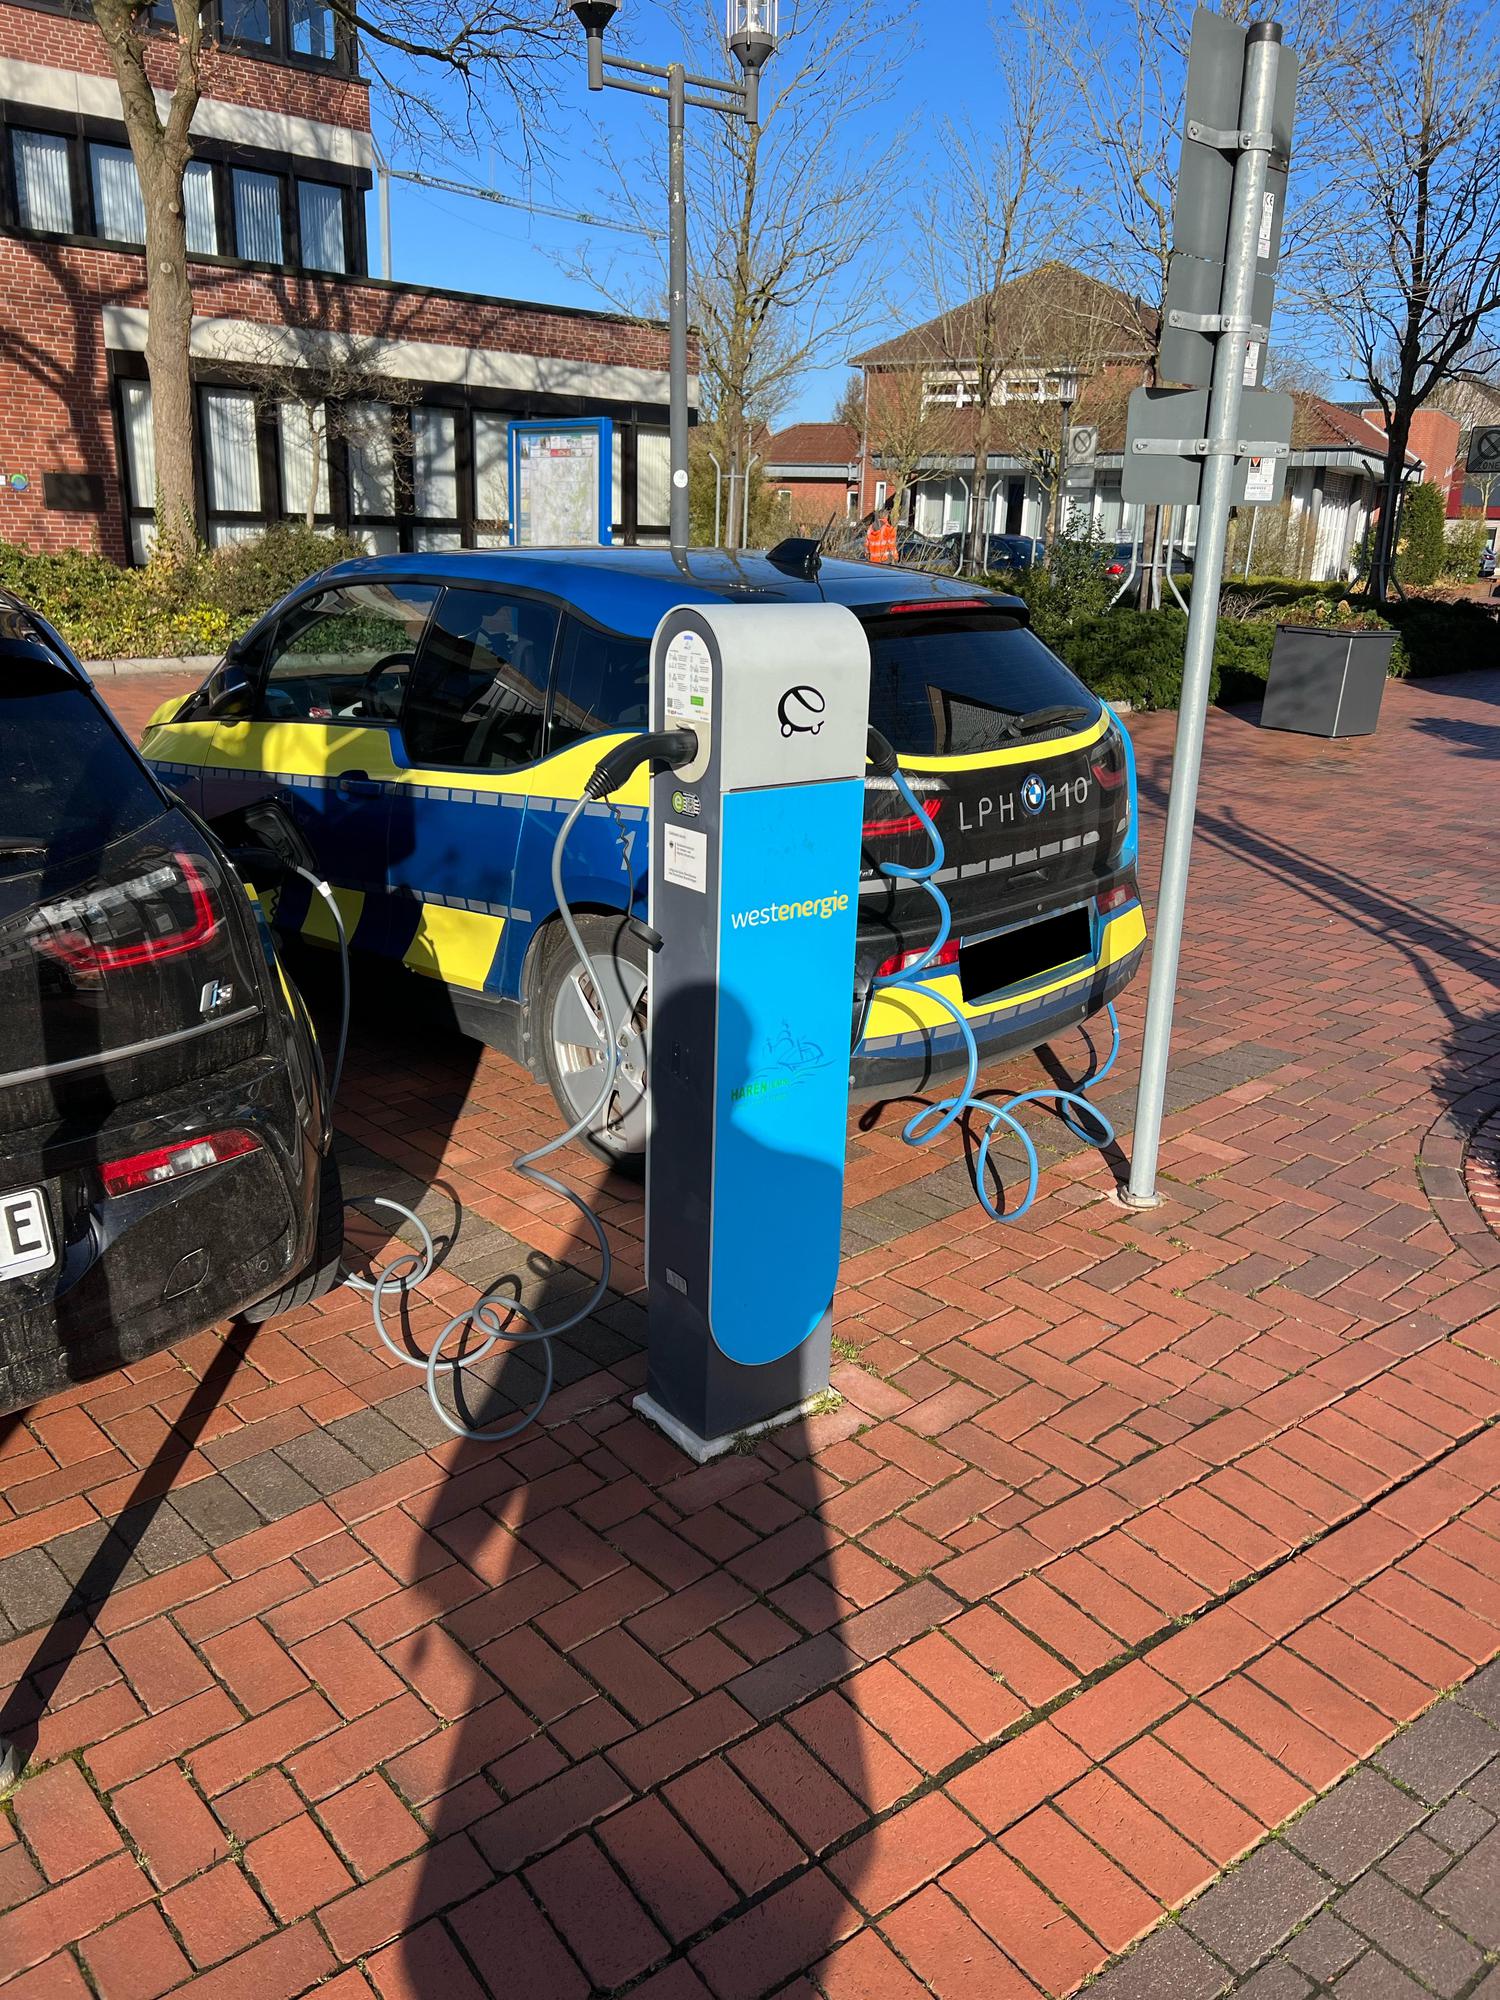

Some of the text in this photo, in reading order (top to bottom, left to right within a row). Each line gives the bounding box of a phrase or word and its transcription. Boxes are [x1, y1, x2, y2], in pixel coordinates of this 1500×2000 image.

[957, 776, 1089, 831] LPH 110
[731, 889, 849, 930] westenergie
[730, 1079, 768, 1102] HAREN
[4, 1200, 43, 1255] E
